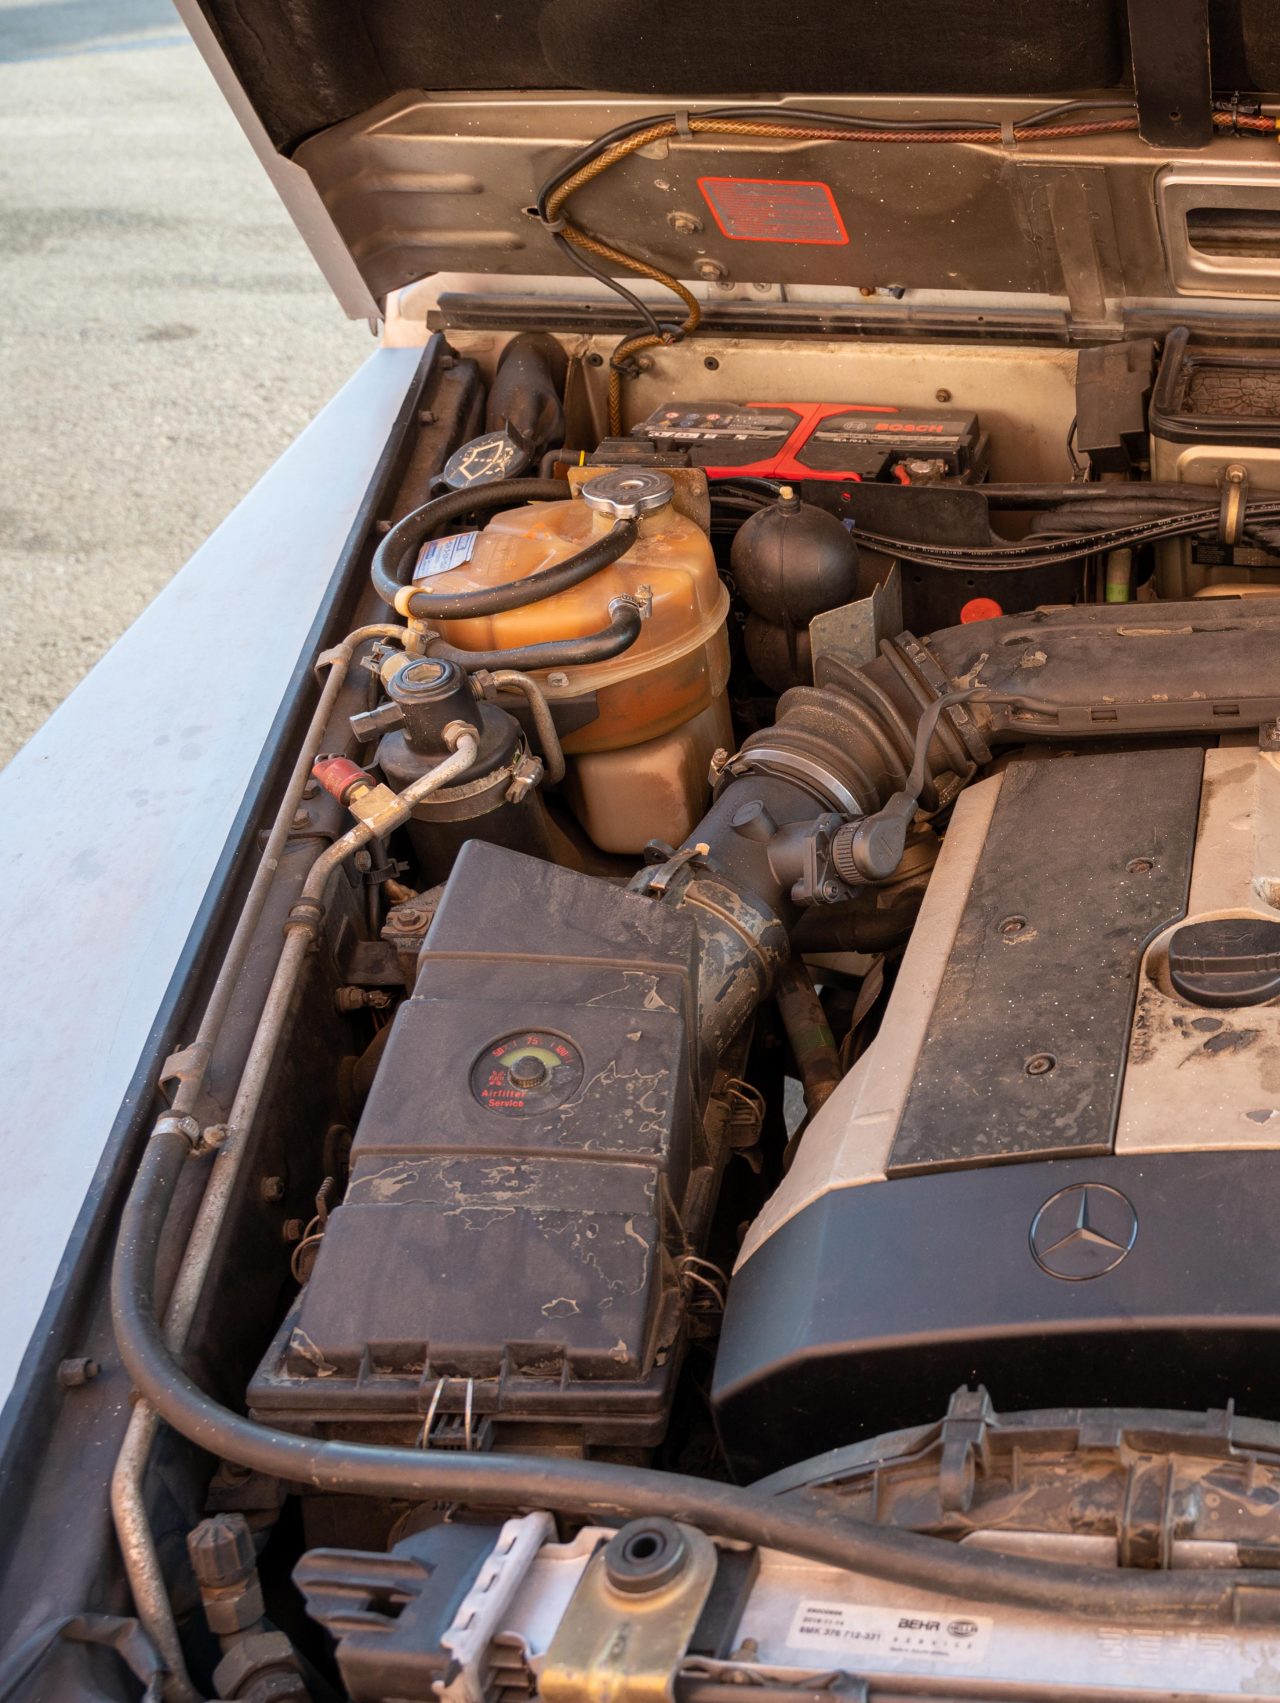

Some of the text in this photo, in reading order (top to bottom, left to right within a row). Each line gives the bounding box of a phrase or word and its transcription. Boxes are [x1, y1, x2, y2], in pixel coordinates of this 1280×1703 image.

[874, 422, 944, 433] BOSCH
[481, 1089, 527, 1098] Airfilter
[488, 1098, 524, 1108] Service
[897, 1617, 941, 1632] BEHR
